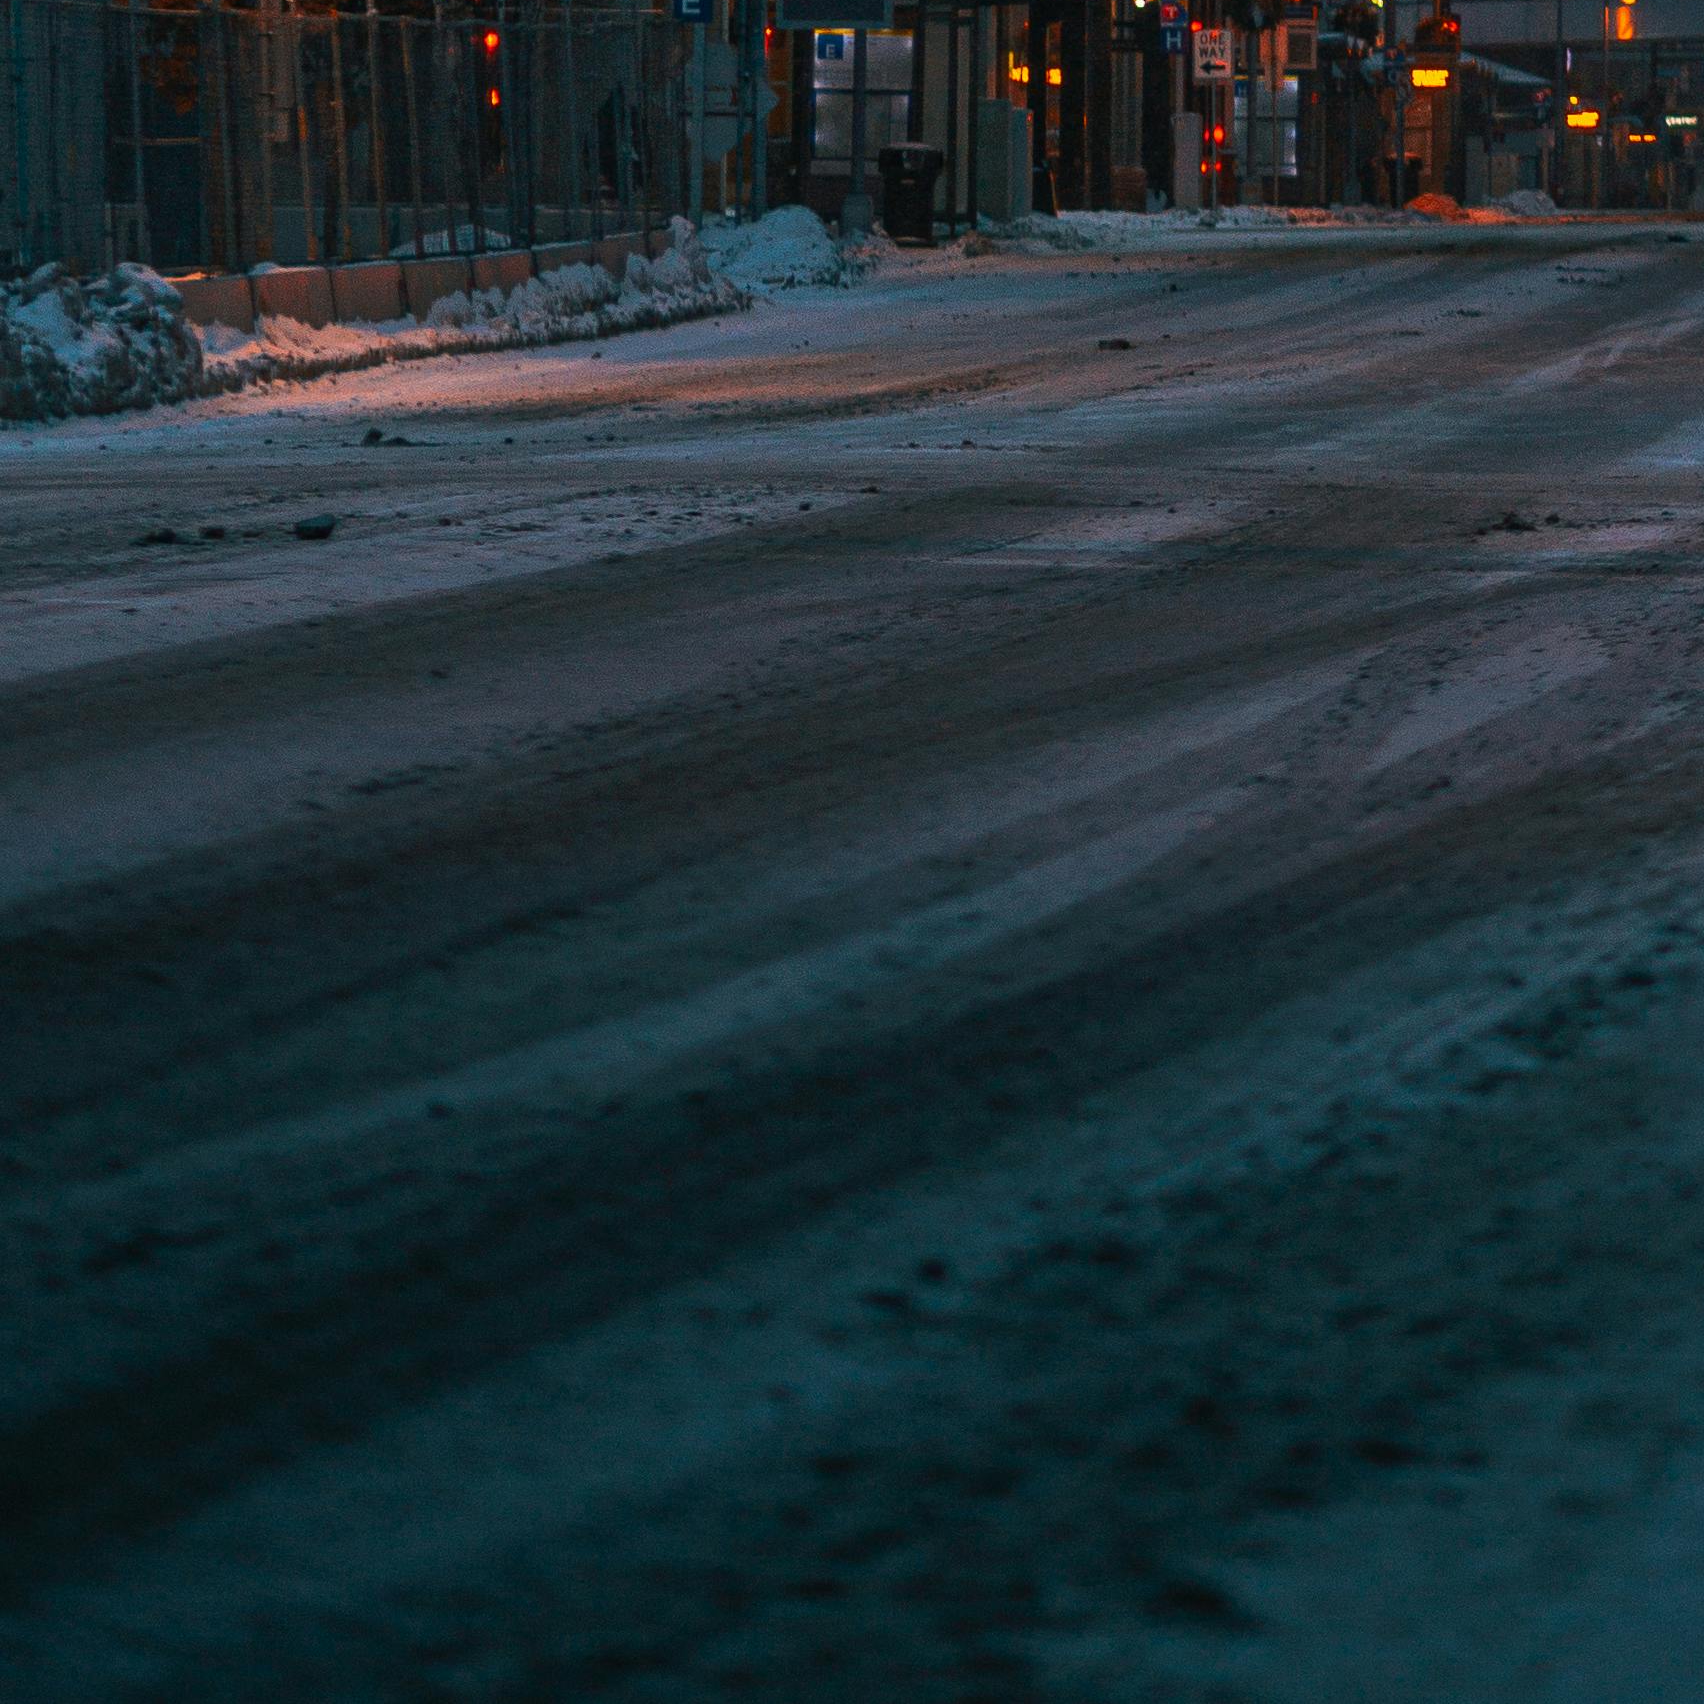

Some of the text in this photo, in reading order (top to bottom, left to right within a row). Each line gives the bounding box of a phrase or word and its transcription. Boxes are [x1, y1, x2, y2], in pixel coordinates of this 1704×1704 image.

[1166, 30, 1182, 50] H
[1200, 33, 1225, 45] ONE
[1199, 46, 1226, 58] WAY
